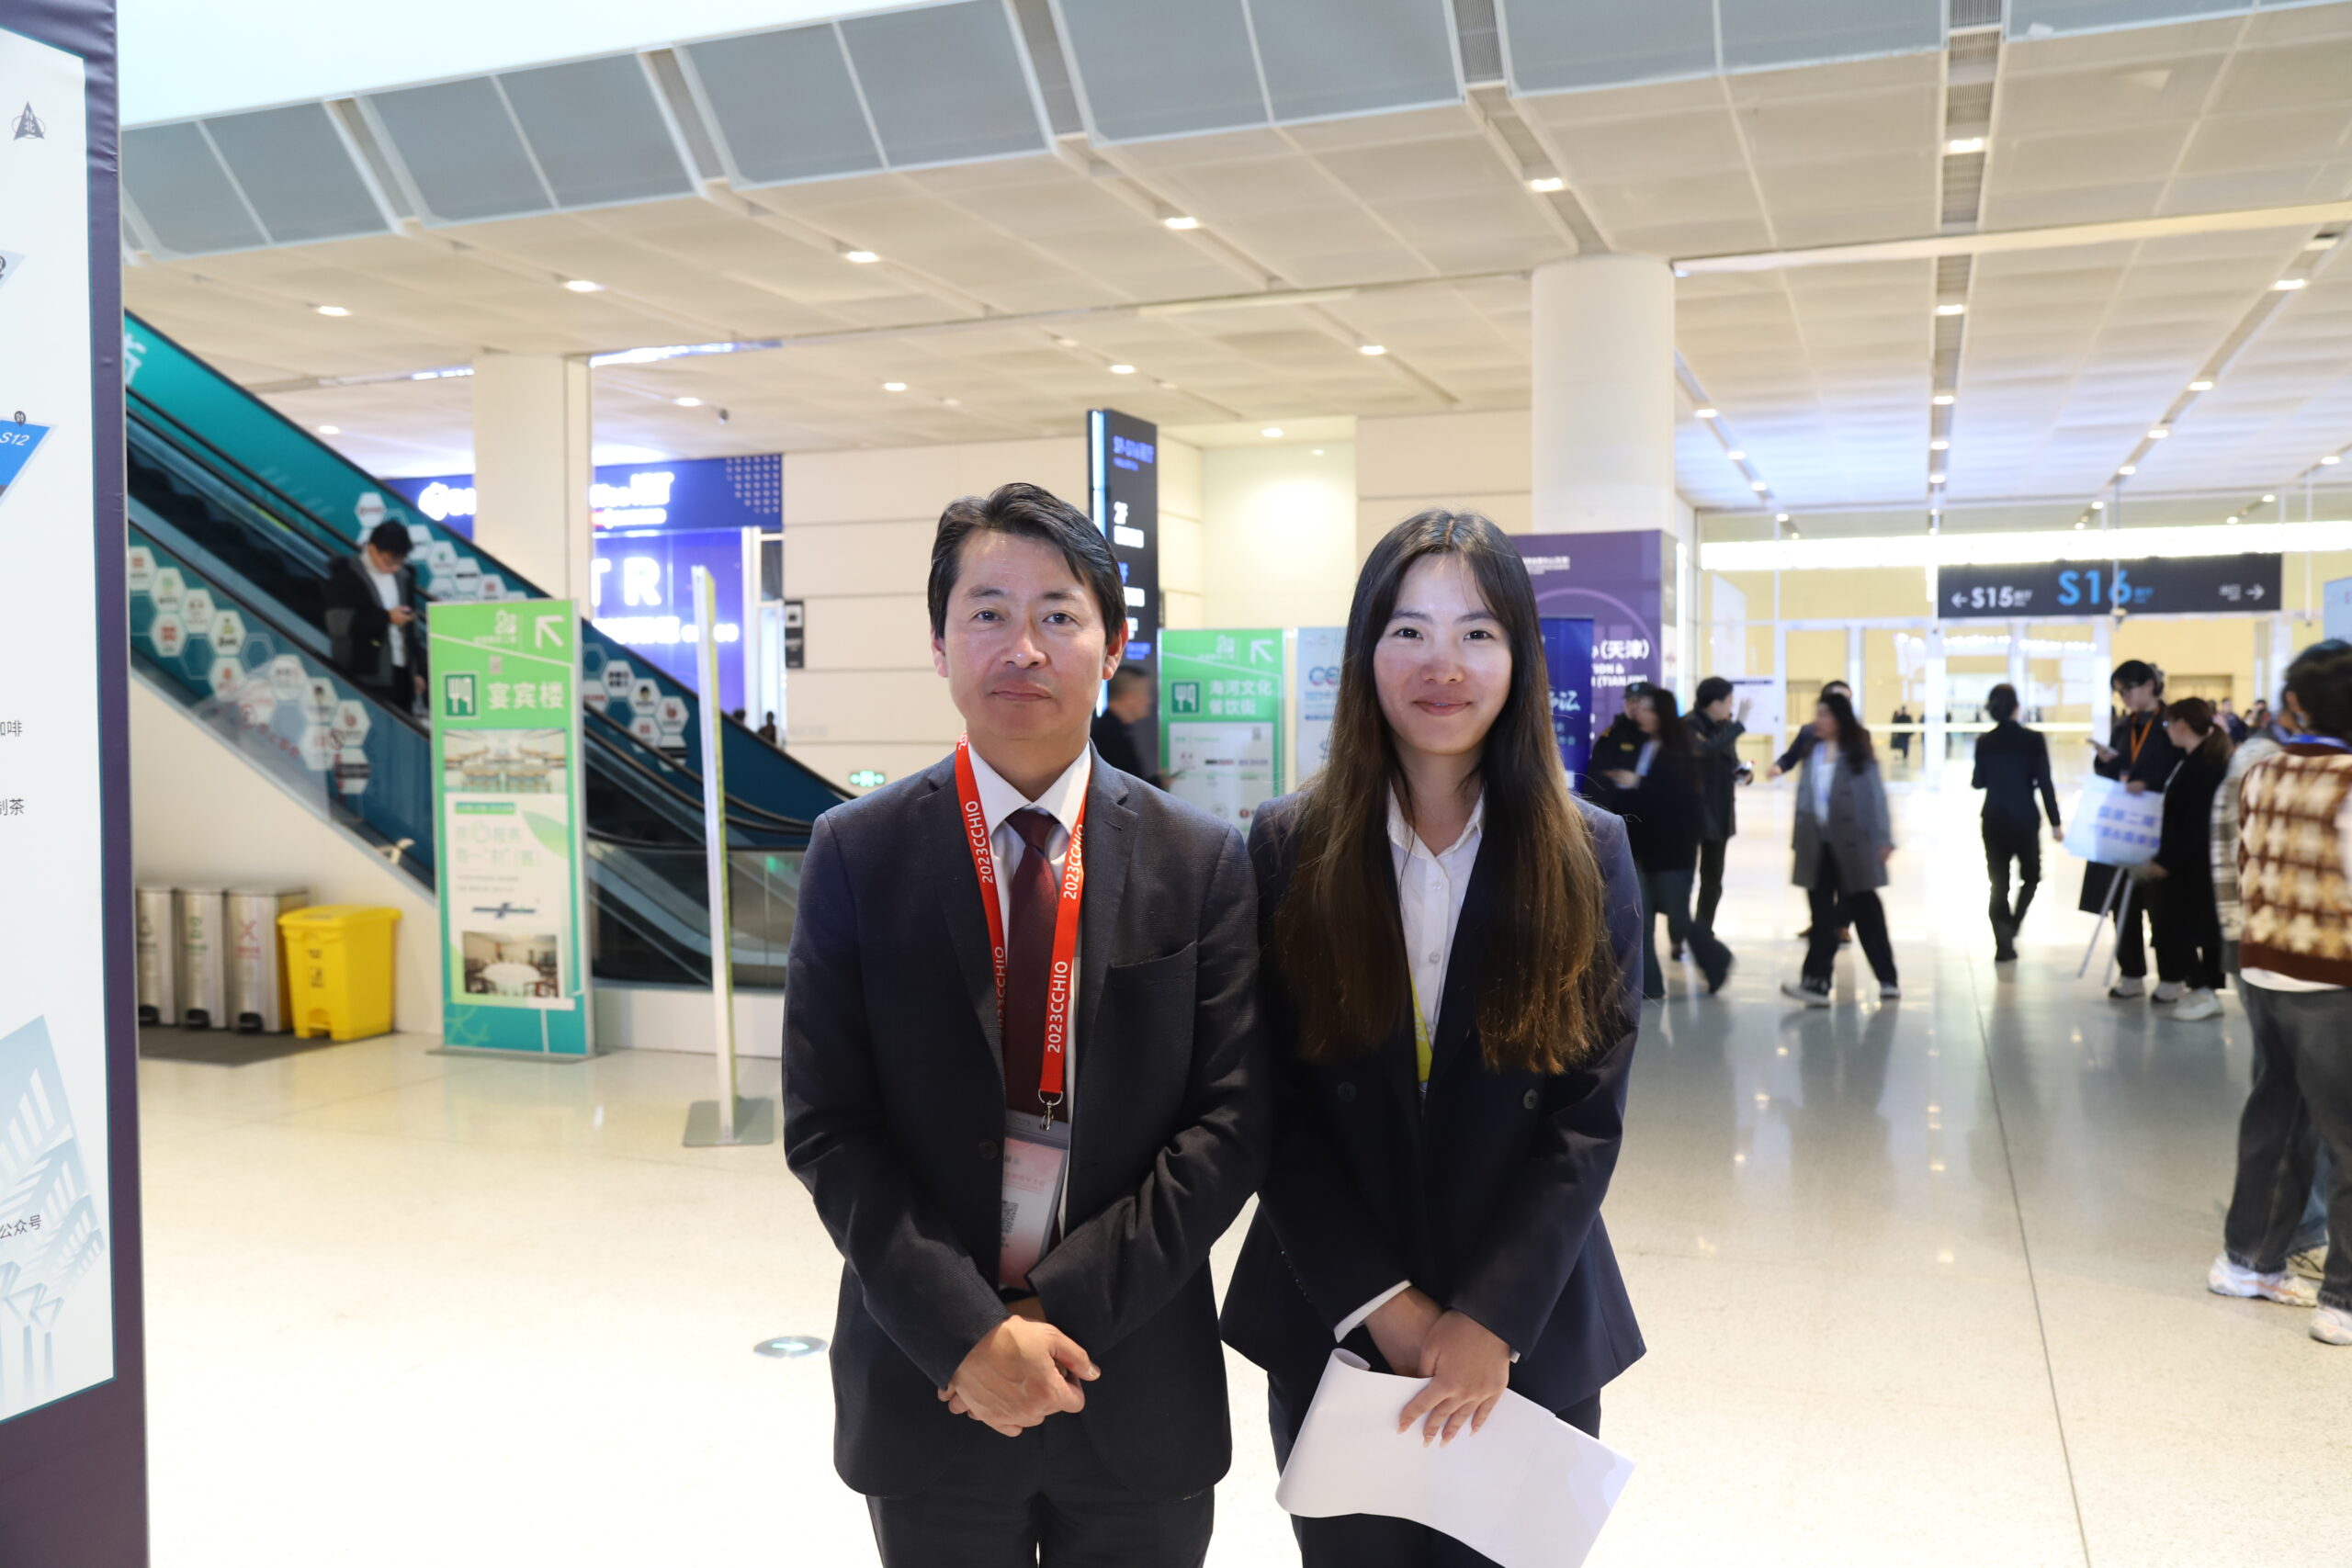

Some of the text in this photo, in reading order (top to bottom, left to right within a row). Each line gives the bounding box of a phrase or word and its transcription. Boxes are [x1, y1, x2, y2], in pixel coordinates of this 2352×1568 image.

[0, 432, 30, 446] S12
[1971, 586, 2014, 609] S15
[2057, 570, 2132, 605] S16
[965, 800, 994, 885] 2023CCHIO
[1062, 823, 1083, 900] 2023CCHIO
[1046, 960, 1069, 1055] 2023CCHIO
[0, 1213, 42, 1239] 公众号
